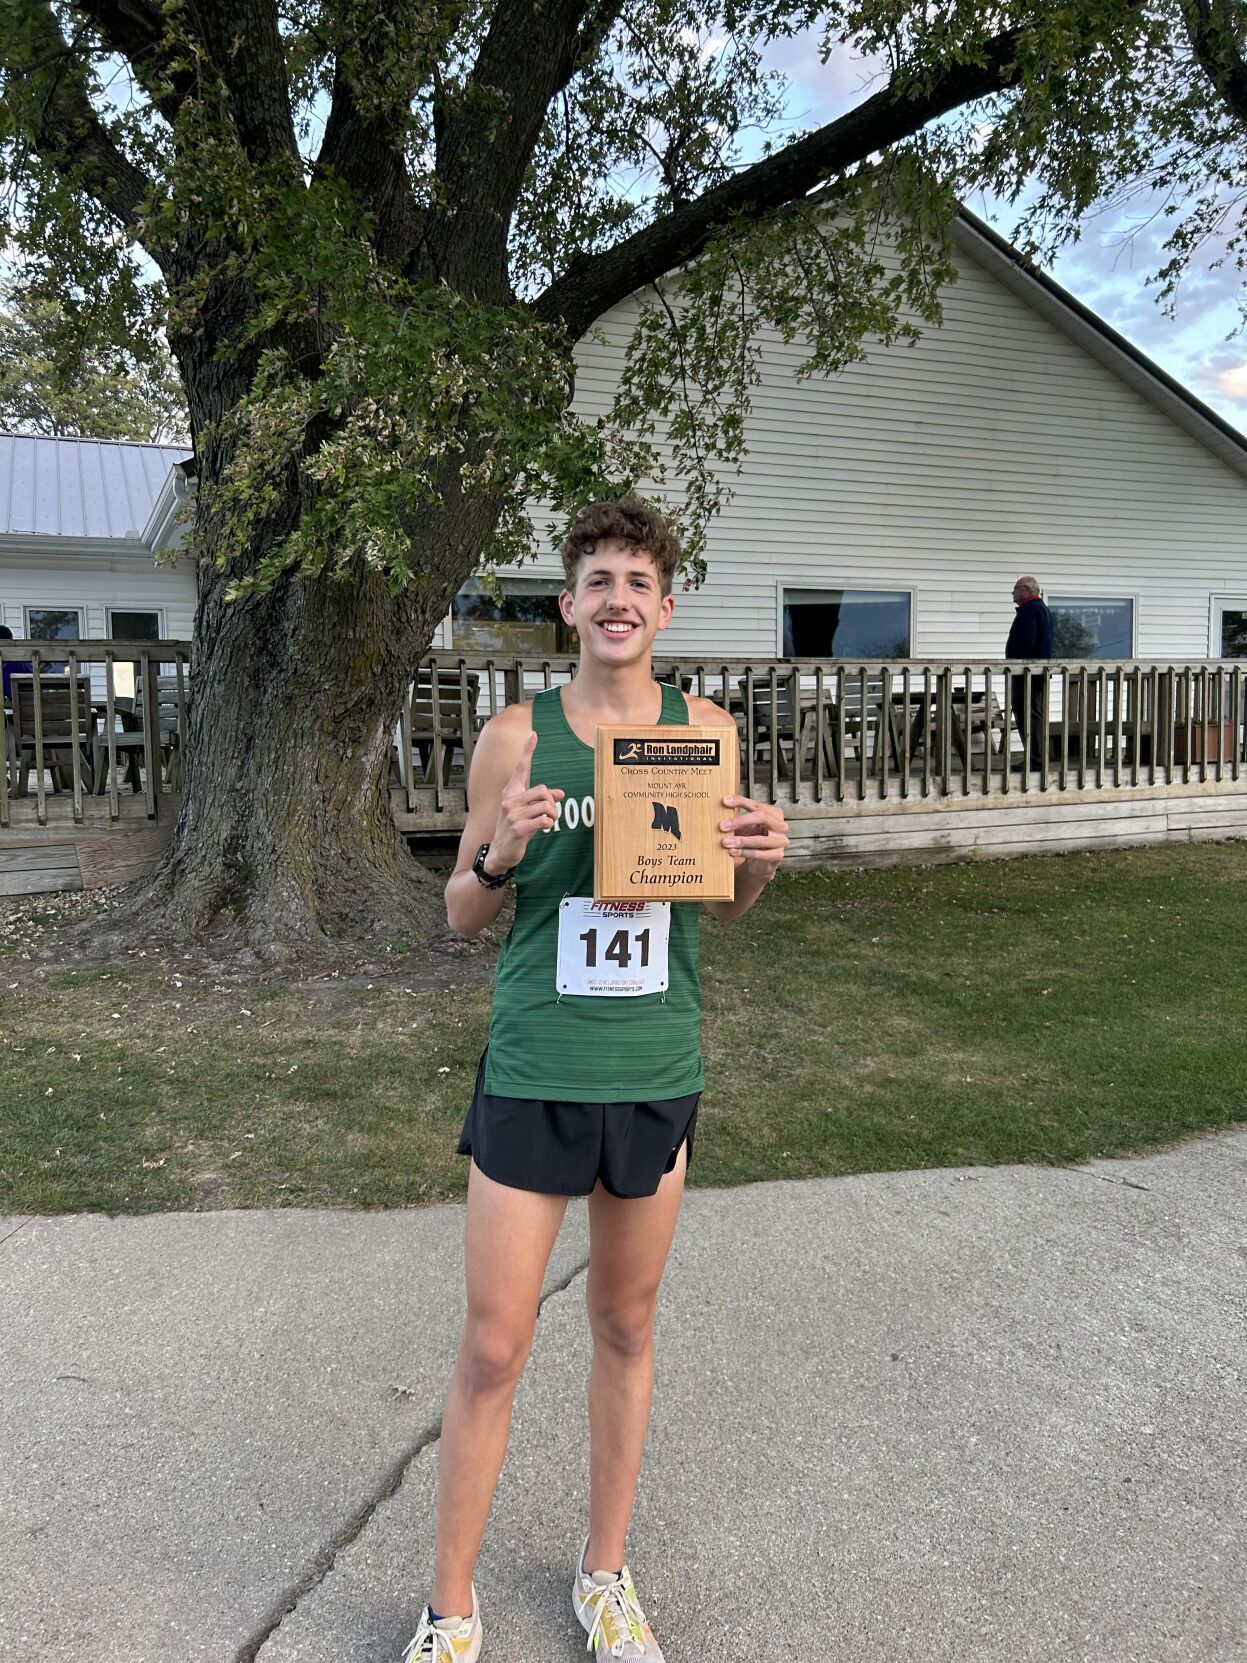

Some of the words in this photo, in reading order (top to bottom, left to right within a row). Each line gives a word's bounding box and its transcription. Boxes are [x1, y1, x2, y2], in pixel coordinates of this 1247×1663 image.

[646, 744, 665, 755] Ron
[666, 744, 713, 757] Landphair
[656, 843, 677, 851] 2023
[637, 855, 662, 868] Boys
[667, 855, 696, 866] Team
[629, 869, 703, 887] Champion
[590, 901, 646, 912] FITNESS
[579, 928, 650, 968] 141
